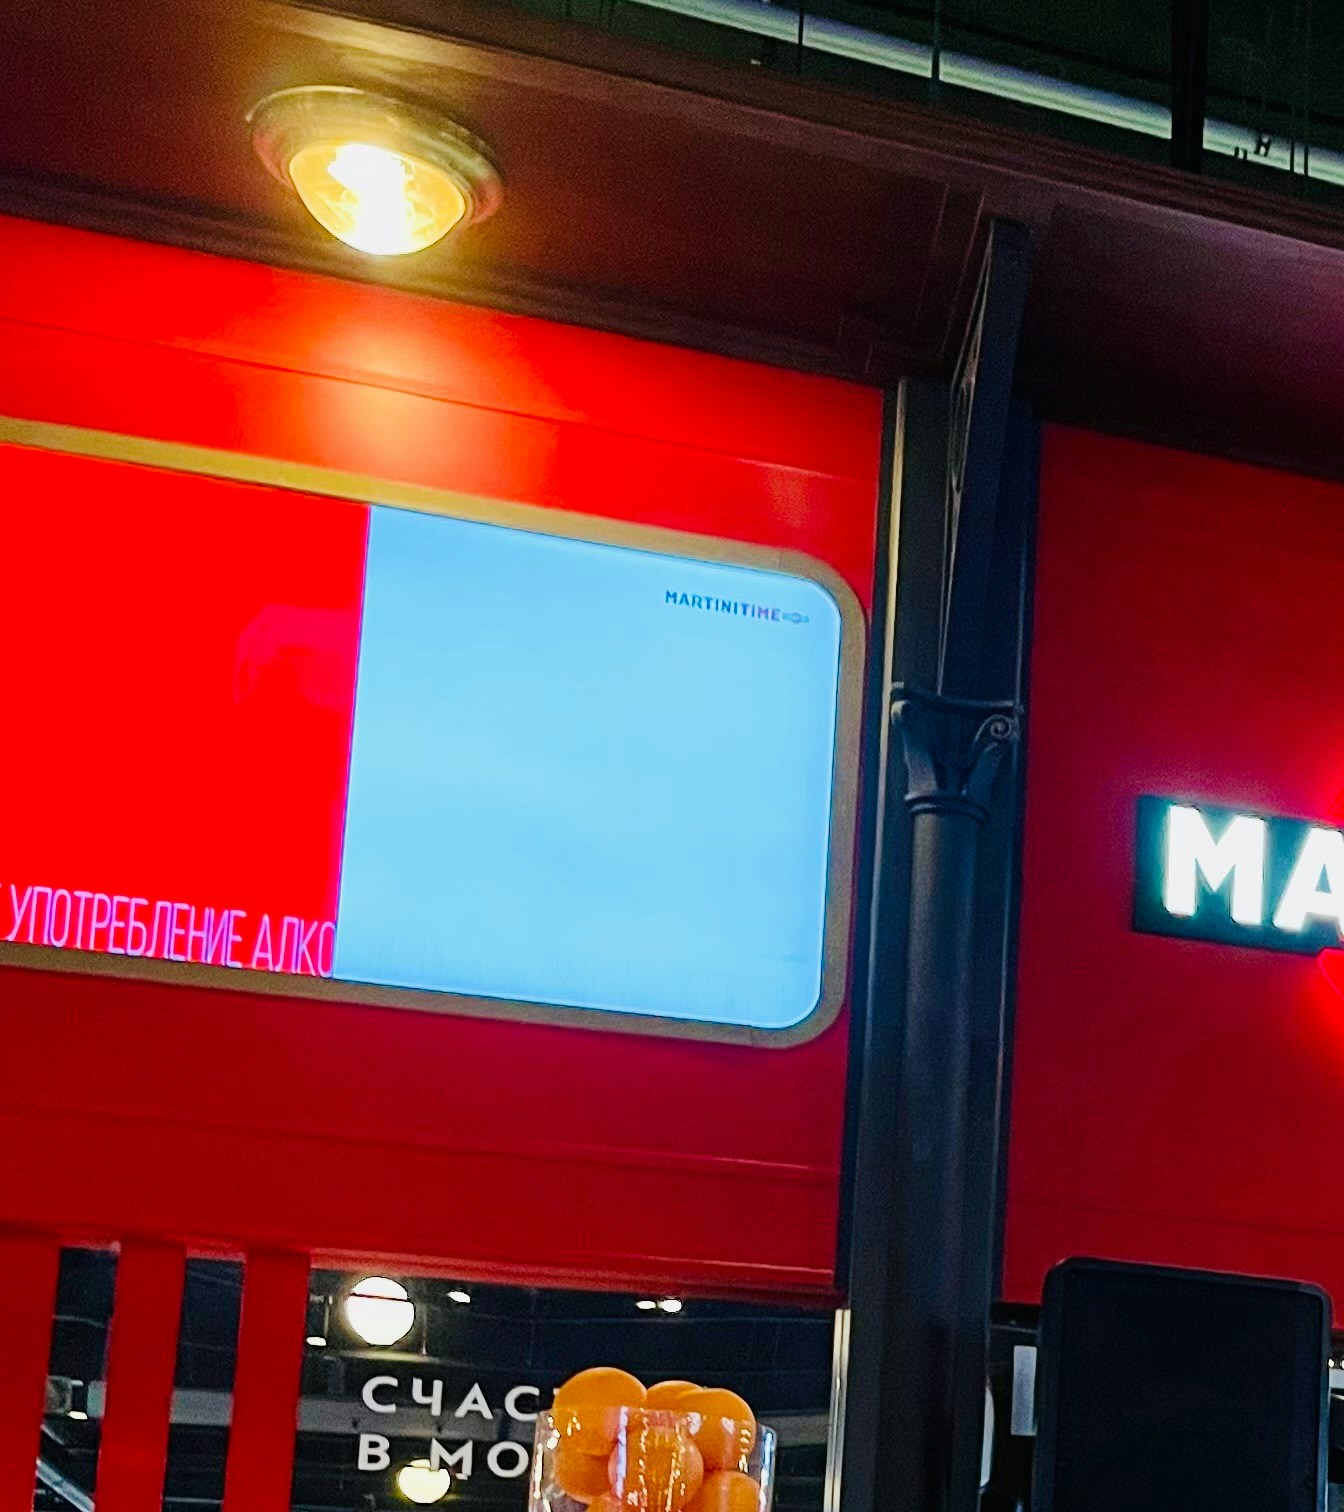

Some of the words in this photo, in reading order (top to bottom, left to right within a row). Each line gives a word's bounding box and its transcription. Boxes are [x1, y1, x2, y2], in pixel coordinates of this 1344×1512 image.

[5, 883, 247, 969] УПОТРЕБЛЕНИЕ
[252, 913, 337, 978] АЛКО
[361, 1375, 558, 1422] СЧАС
[358, 1434, 391, 1471] В
